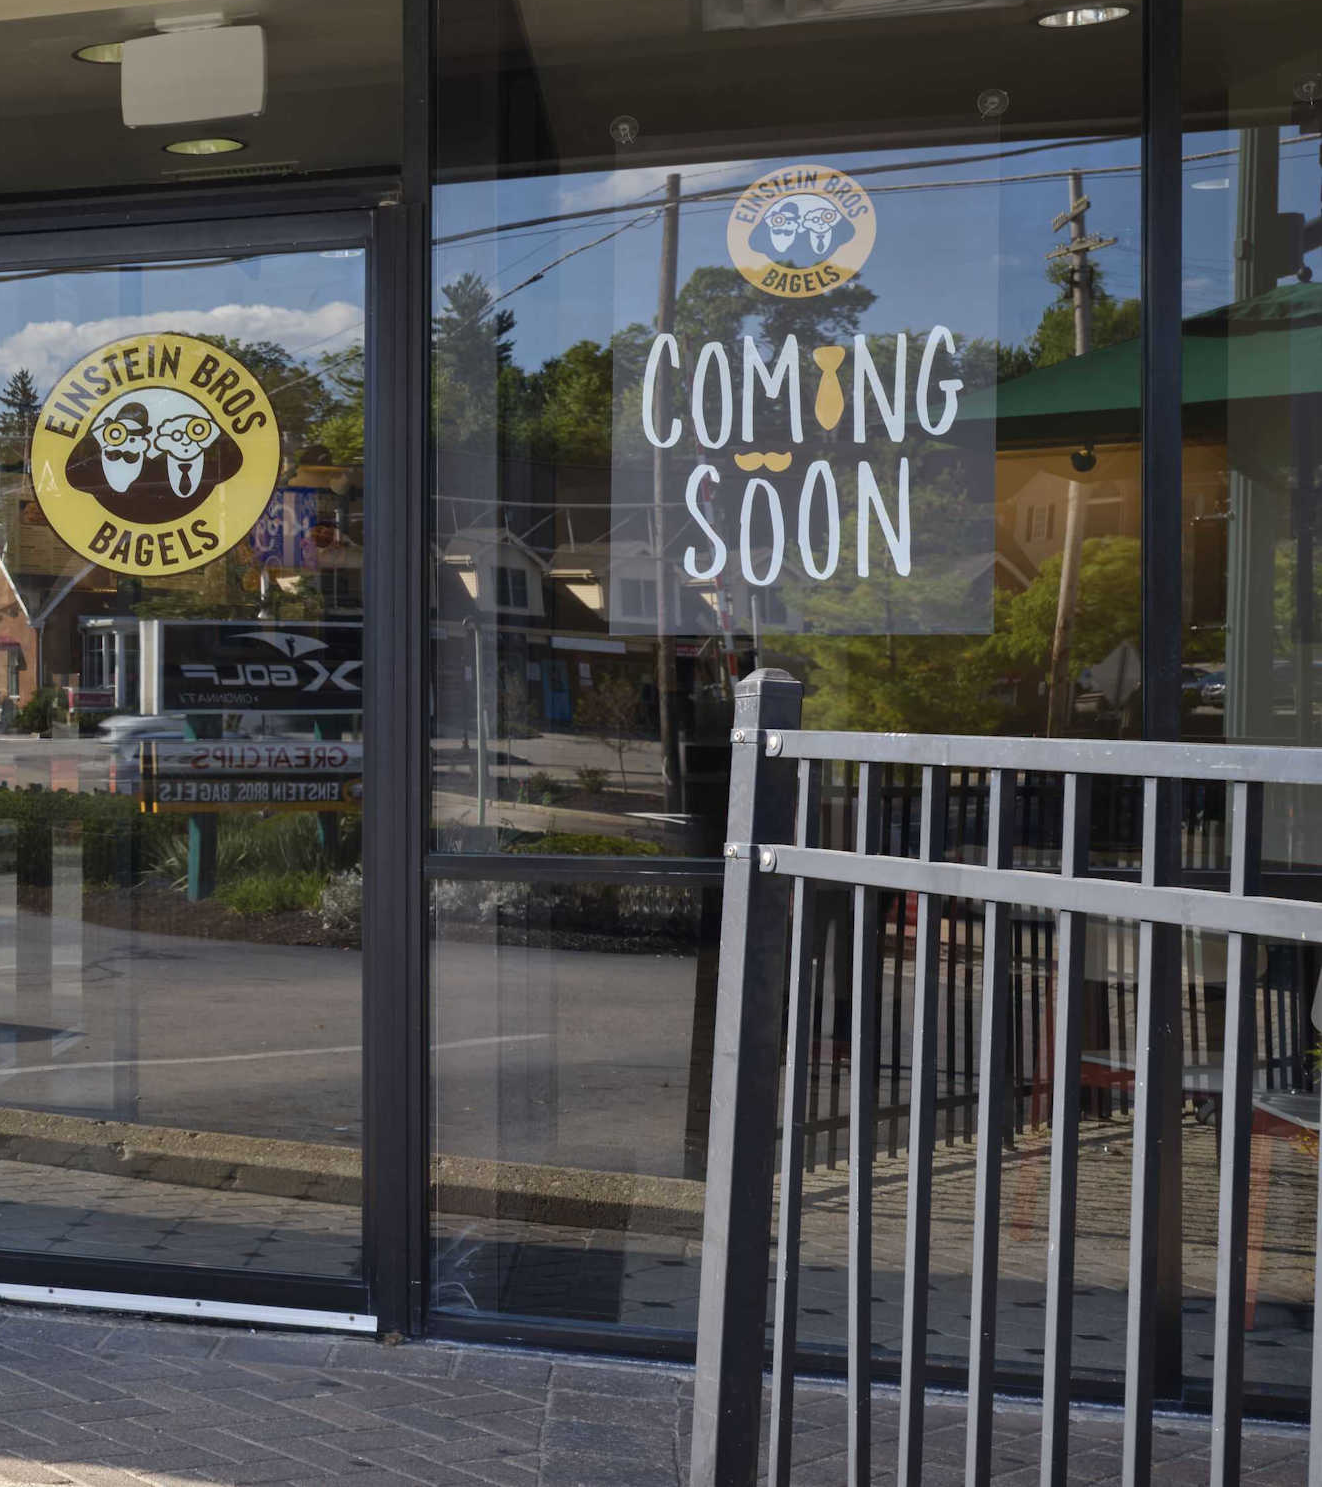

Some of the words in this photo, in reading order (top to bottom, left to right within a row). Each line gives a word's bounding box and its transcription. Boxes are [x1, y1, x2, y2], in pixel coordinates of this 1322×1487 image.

[734, 170, 817, 224] EINSTEIN
[823, 175, 869, 219] BROS
[760, 265, 841, 293] BAGELS
[44, 344, 182, 440] EINSTEIN
[189, 354, 267, 435] BROS
[88, 519, 220, 568] BAGELS
[683, 456, 911, 587] SOON
